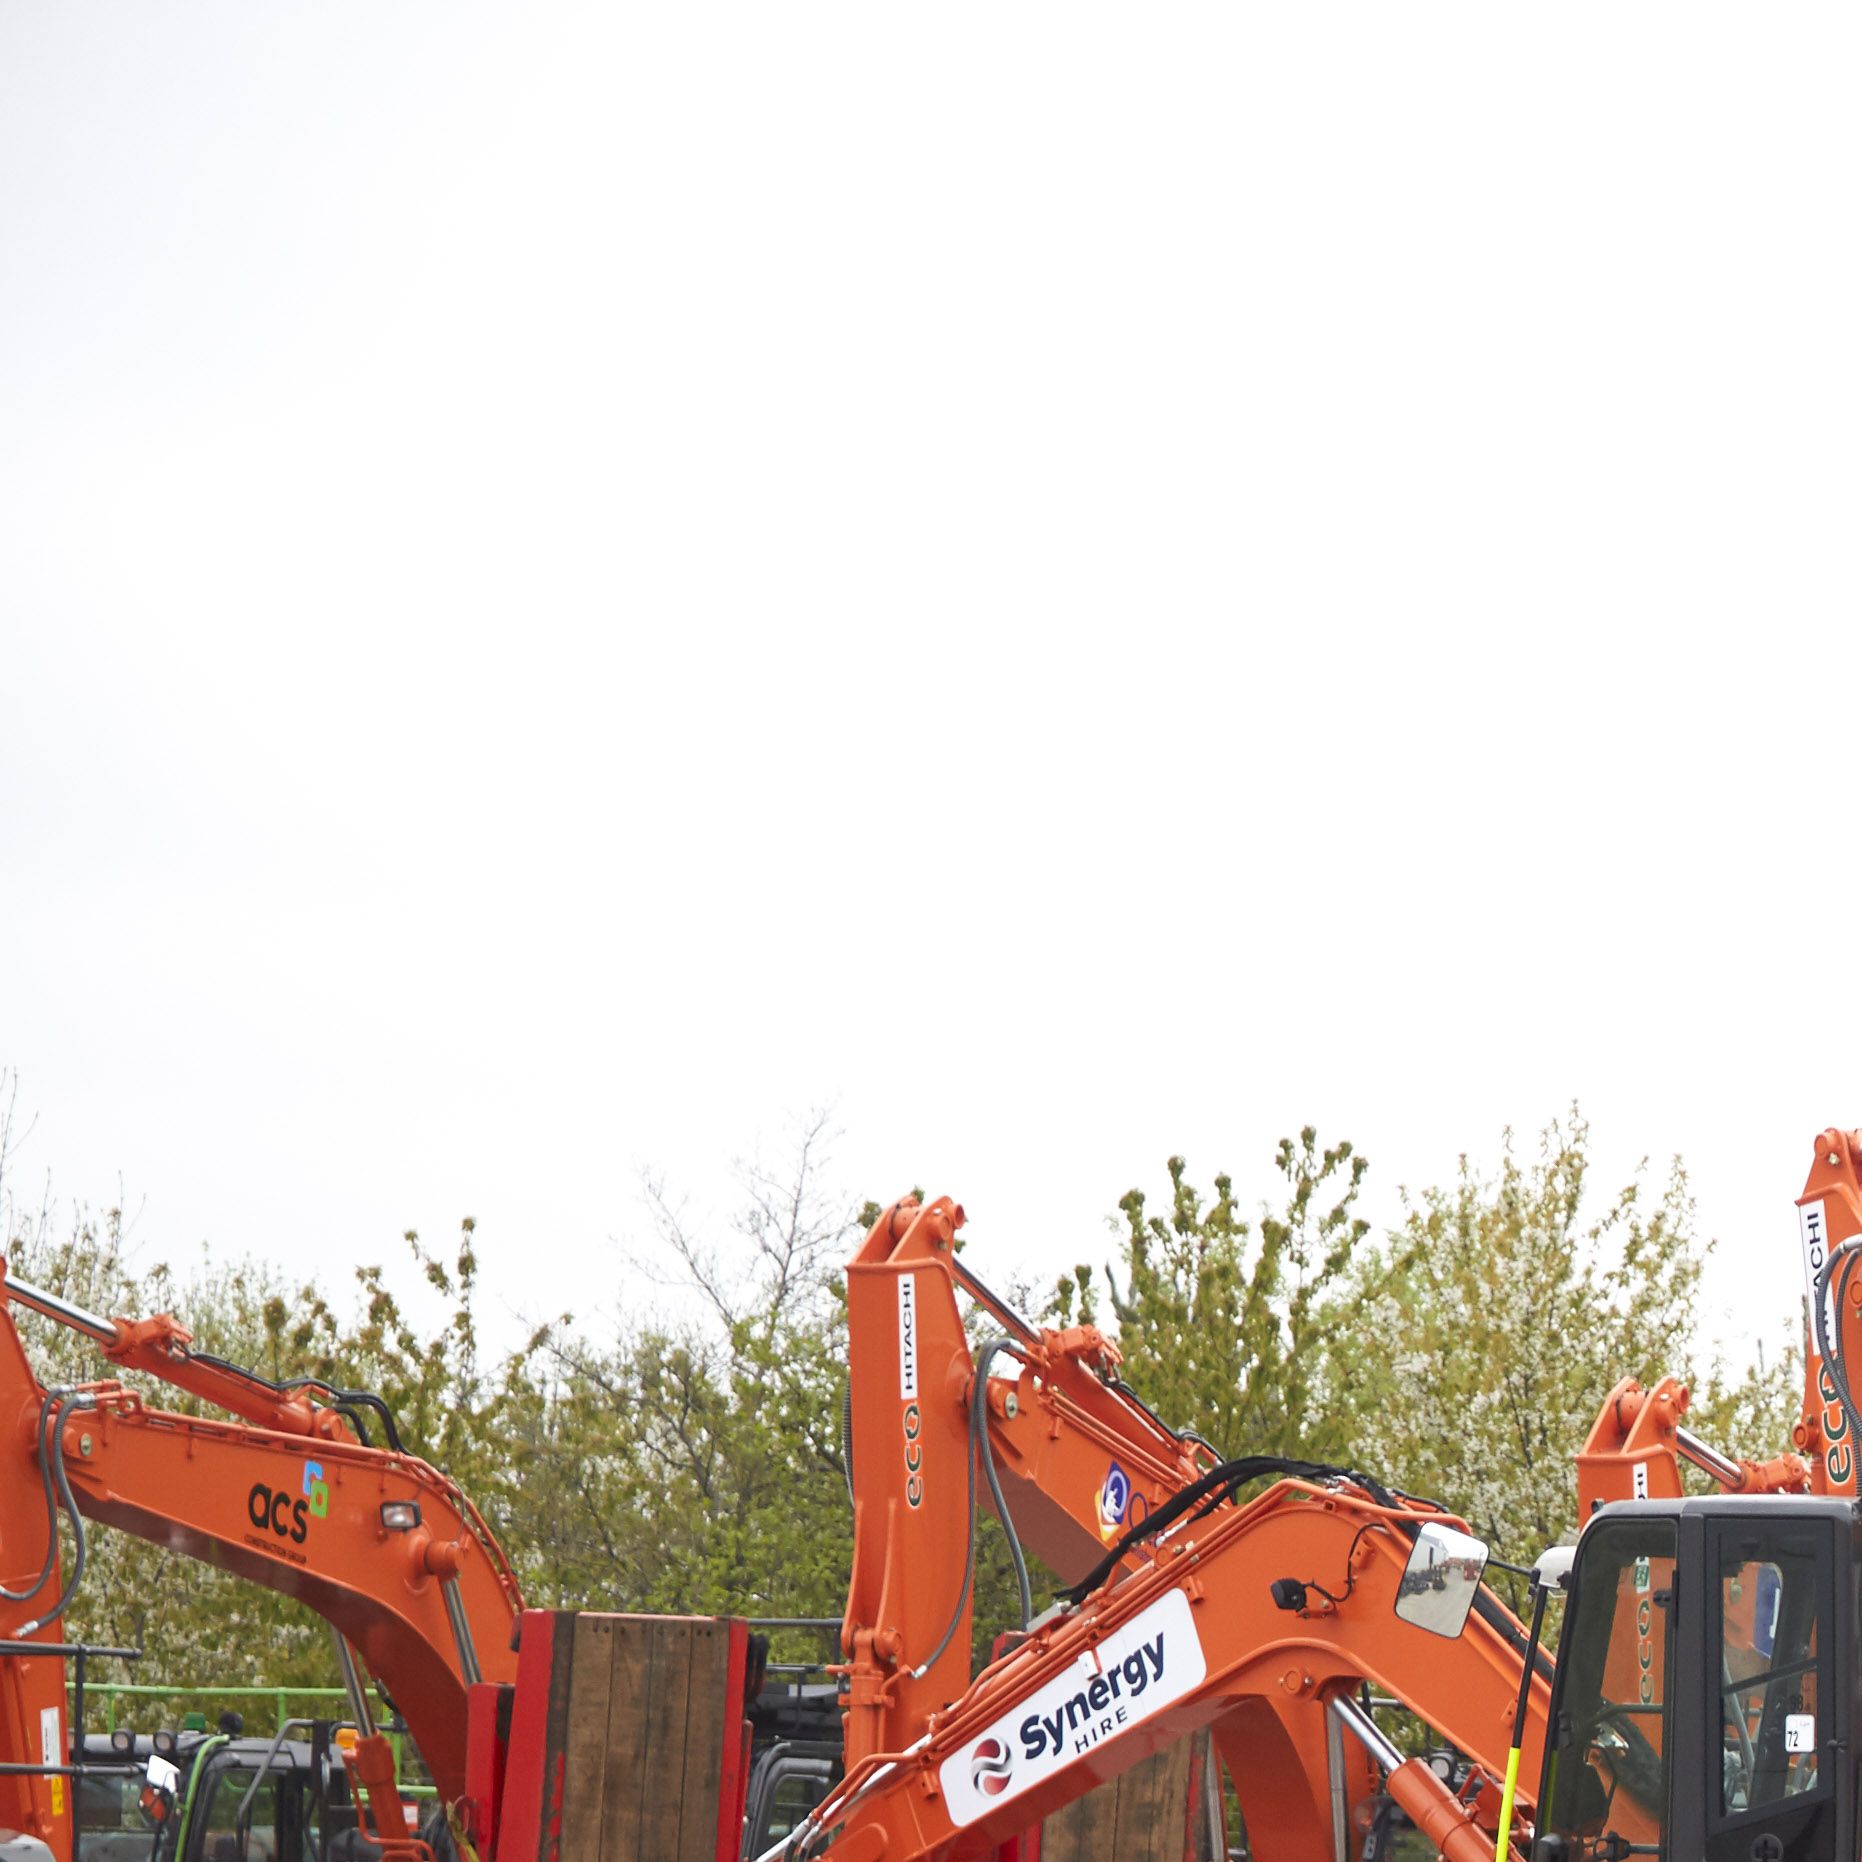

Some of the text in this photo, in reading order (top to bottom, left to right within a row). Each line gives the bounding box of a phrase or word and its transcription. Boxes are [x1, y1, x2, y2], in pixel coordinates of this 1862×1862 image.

[903, 1283, 913, 1390] HITACHI
[1020, 1632, 1164, 1760] Synergy
[1075, 1706, 1128, 1754] HIRE
[1788, 1730, 1798, 1747] 72
